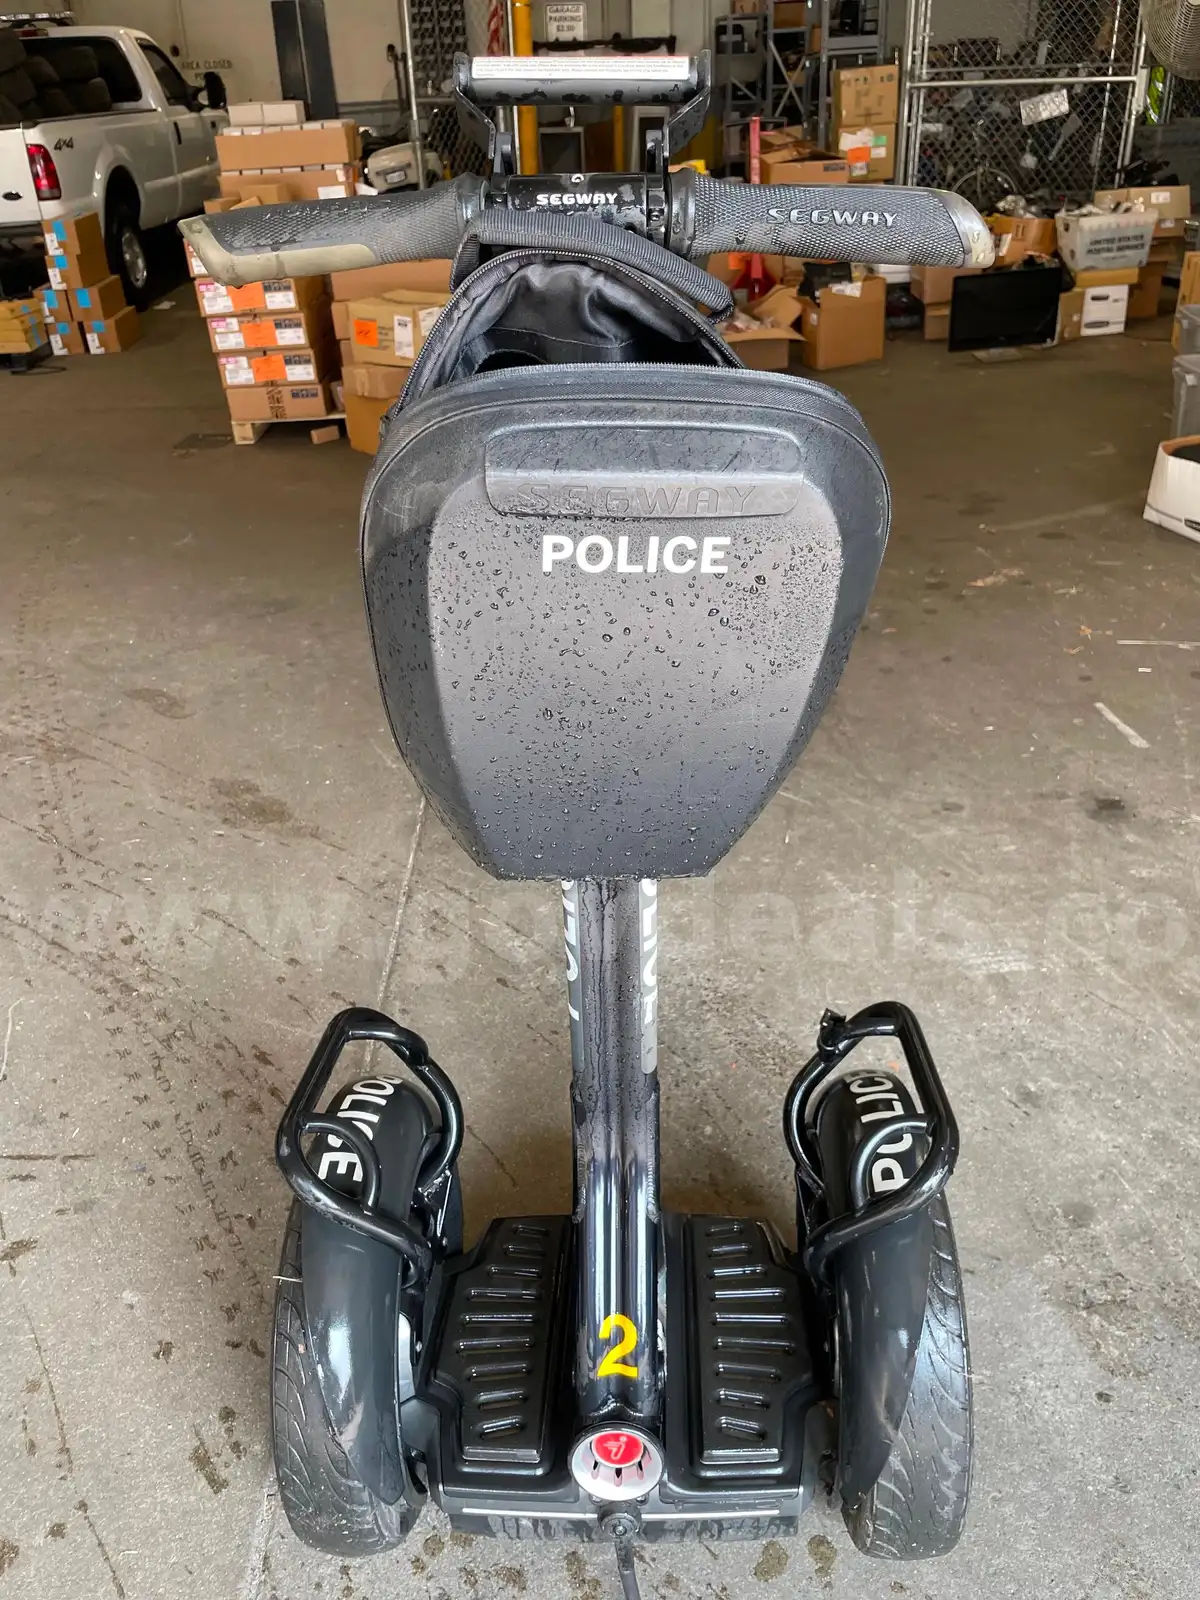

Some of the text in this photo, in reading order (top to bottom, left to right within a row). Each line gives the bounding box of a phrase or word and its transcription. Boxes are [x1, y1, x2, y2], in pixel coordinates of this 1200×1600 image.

[548, 5, 581, 14] GARAGE
[548, 15, 582, 23] PARKING
[536, 192, 618, 206] SEGWAY
[766, 207, 898, 228] SEGWAY
[516, 482, 757, 516] SEGWAY
[541, 534, 732, 575] POLICE
[596, 1313, 639, 1378] 2
